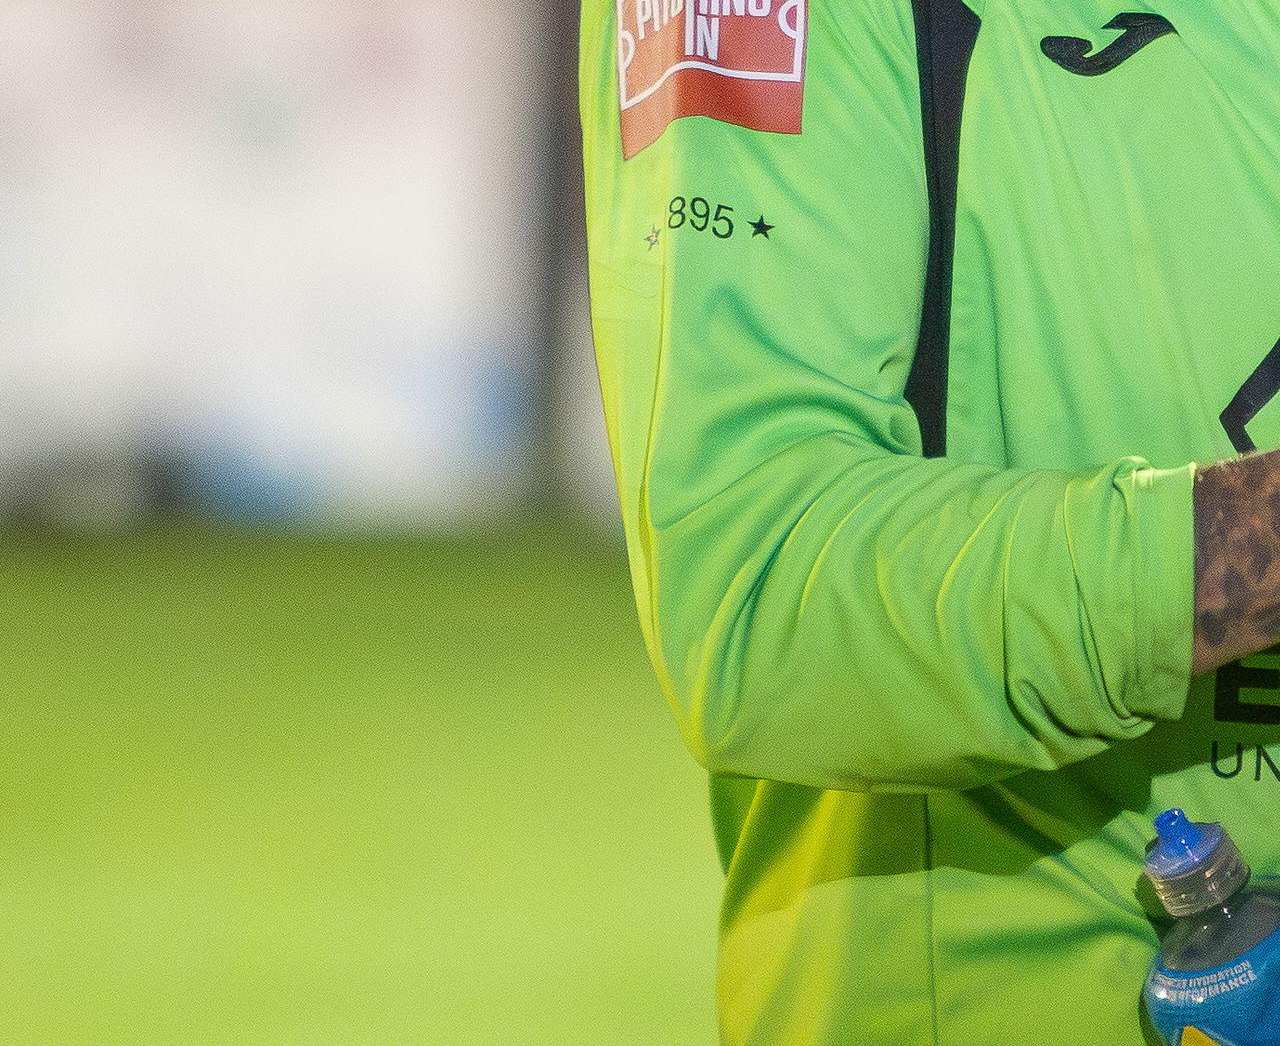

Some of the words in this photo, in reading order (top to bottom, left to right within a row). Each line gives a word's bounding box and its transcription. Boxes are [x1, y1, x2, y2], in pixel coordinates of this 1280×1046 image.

[684, 14, 720, 61] IN
[668, 196, 734, 239] 895
[1157, 970, 1257, 1003] ERFORMANCE
